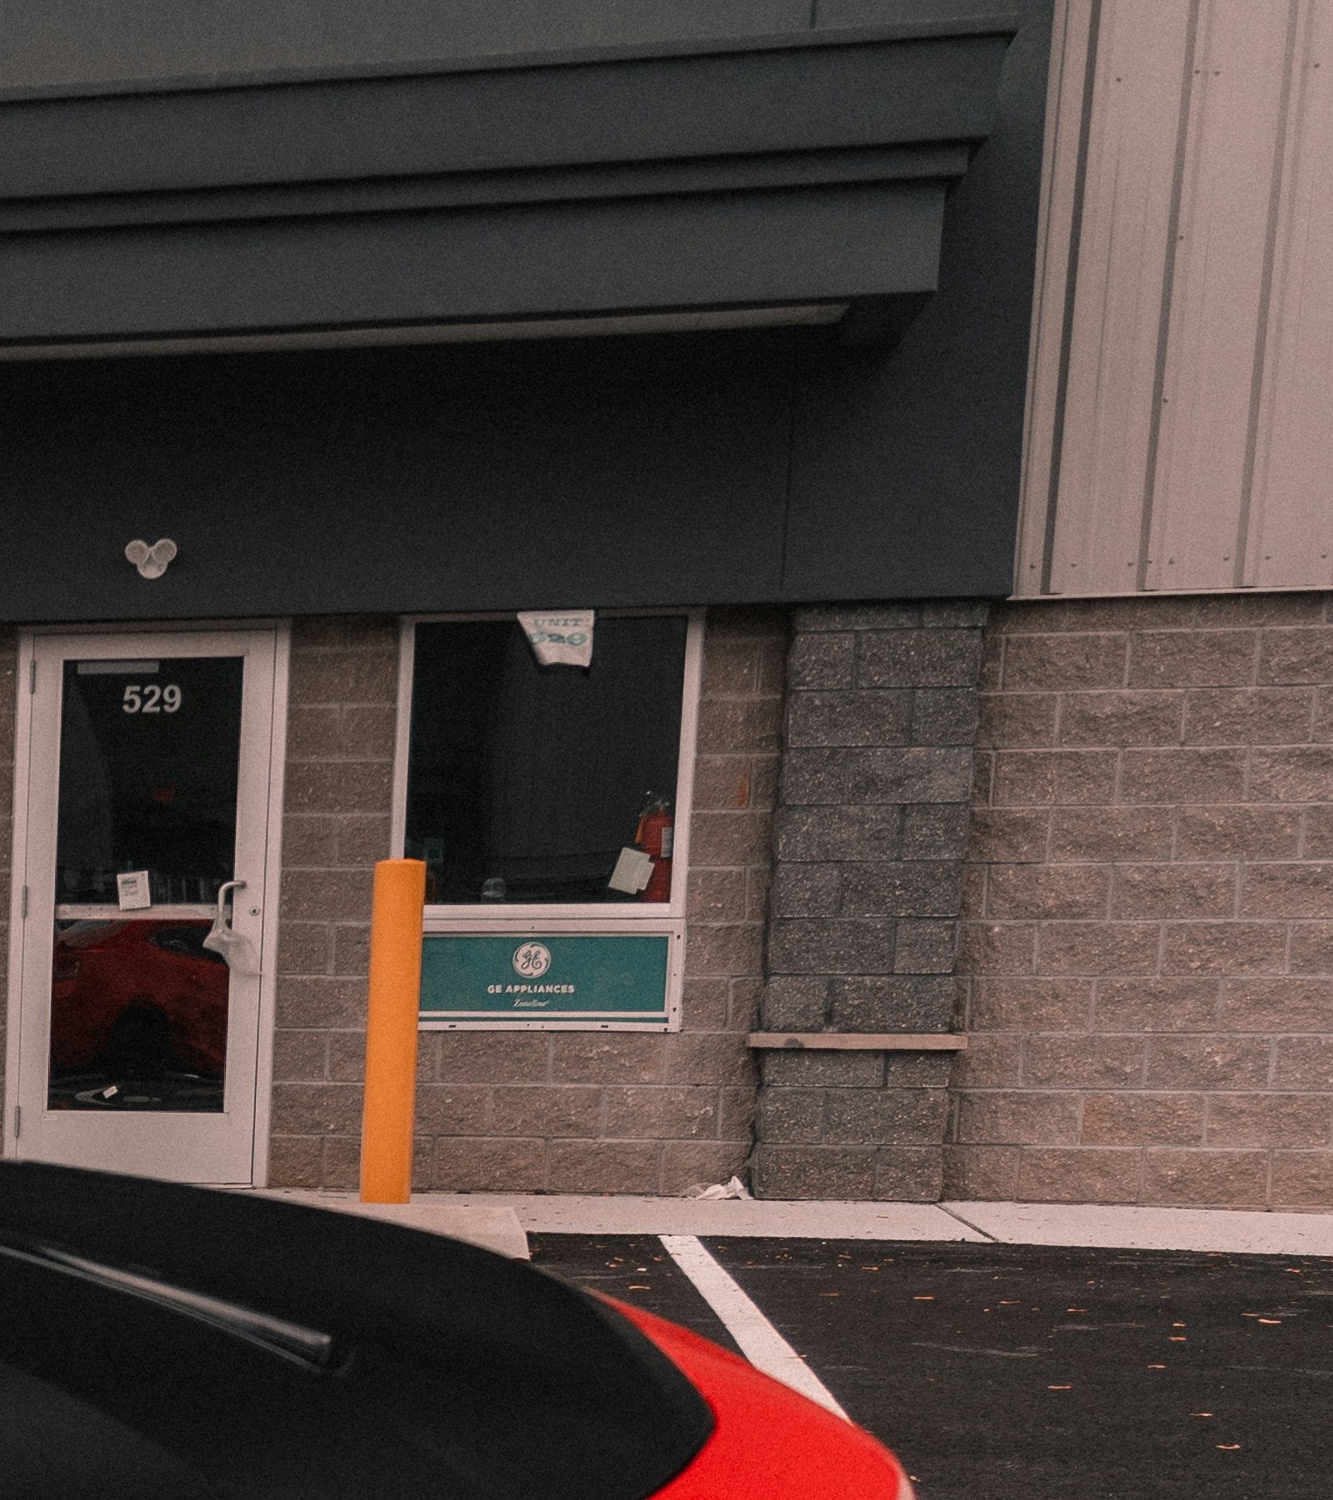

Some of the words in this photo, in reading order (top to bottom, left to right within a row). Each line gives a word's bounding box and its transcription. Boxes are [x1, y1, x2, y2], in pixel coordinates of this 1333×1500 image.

[534, 618, 582, 627] UNIT
[122, 684, 182, 714] 529
[487, 984, 502, 994] GE
[505, 984, 575, 994] APPLIANCES
